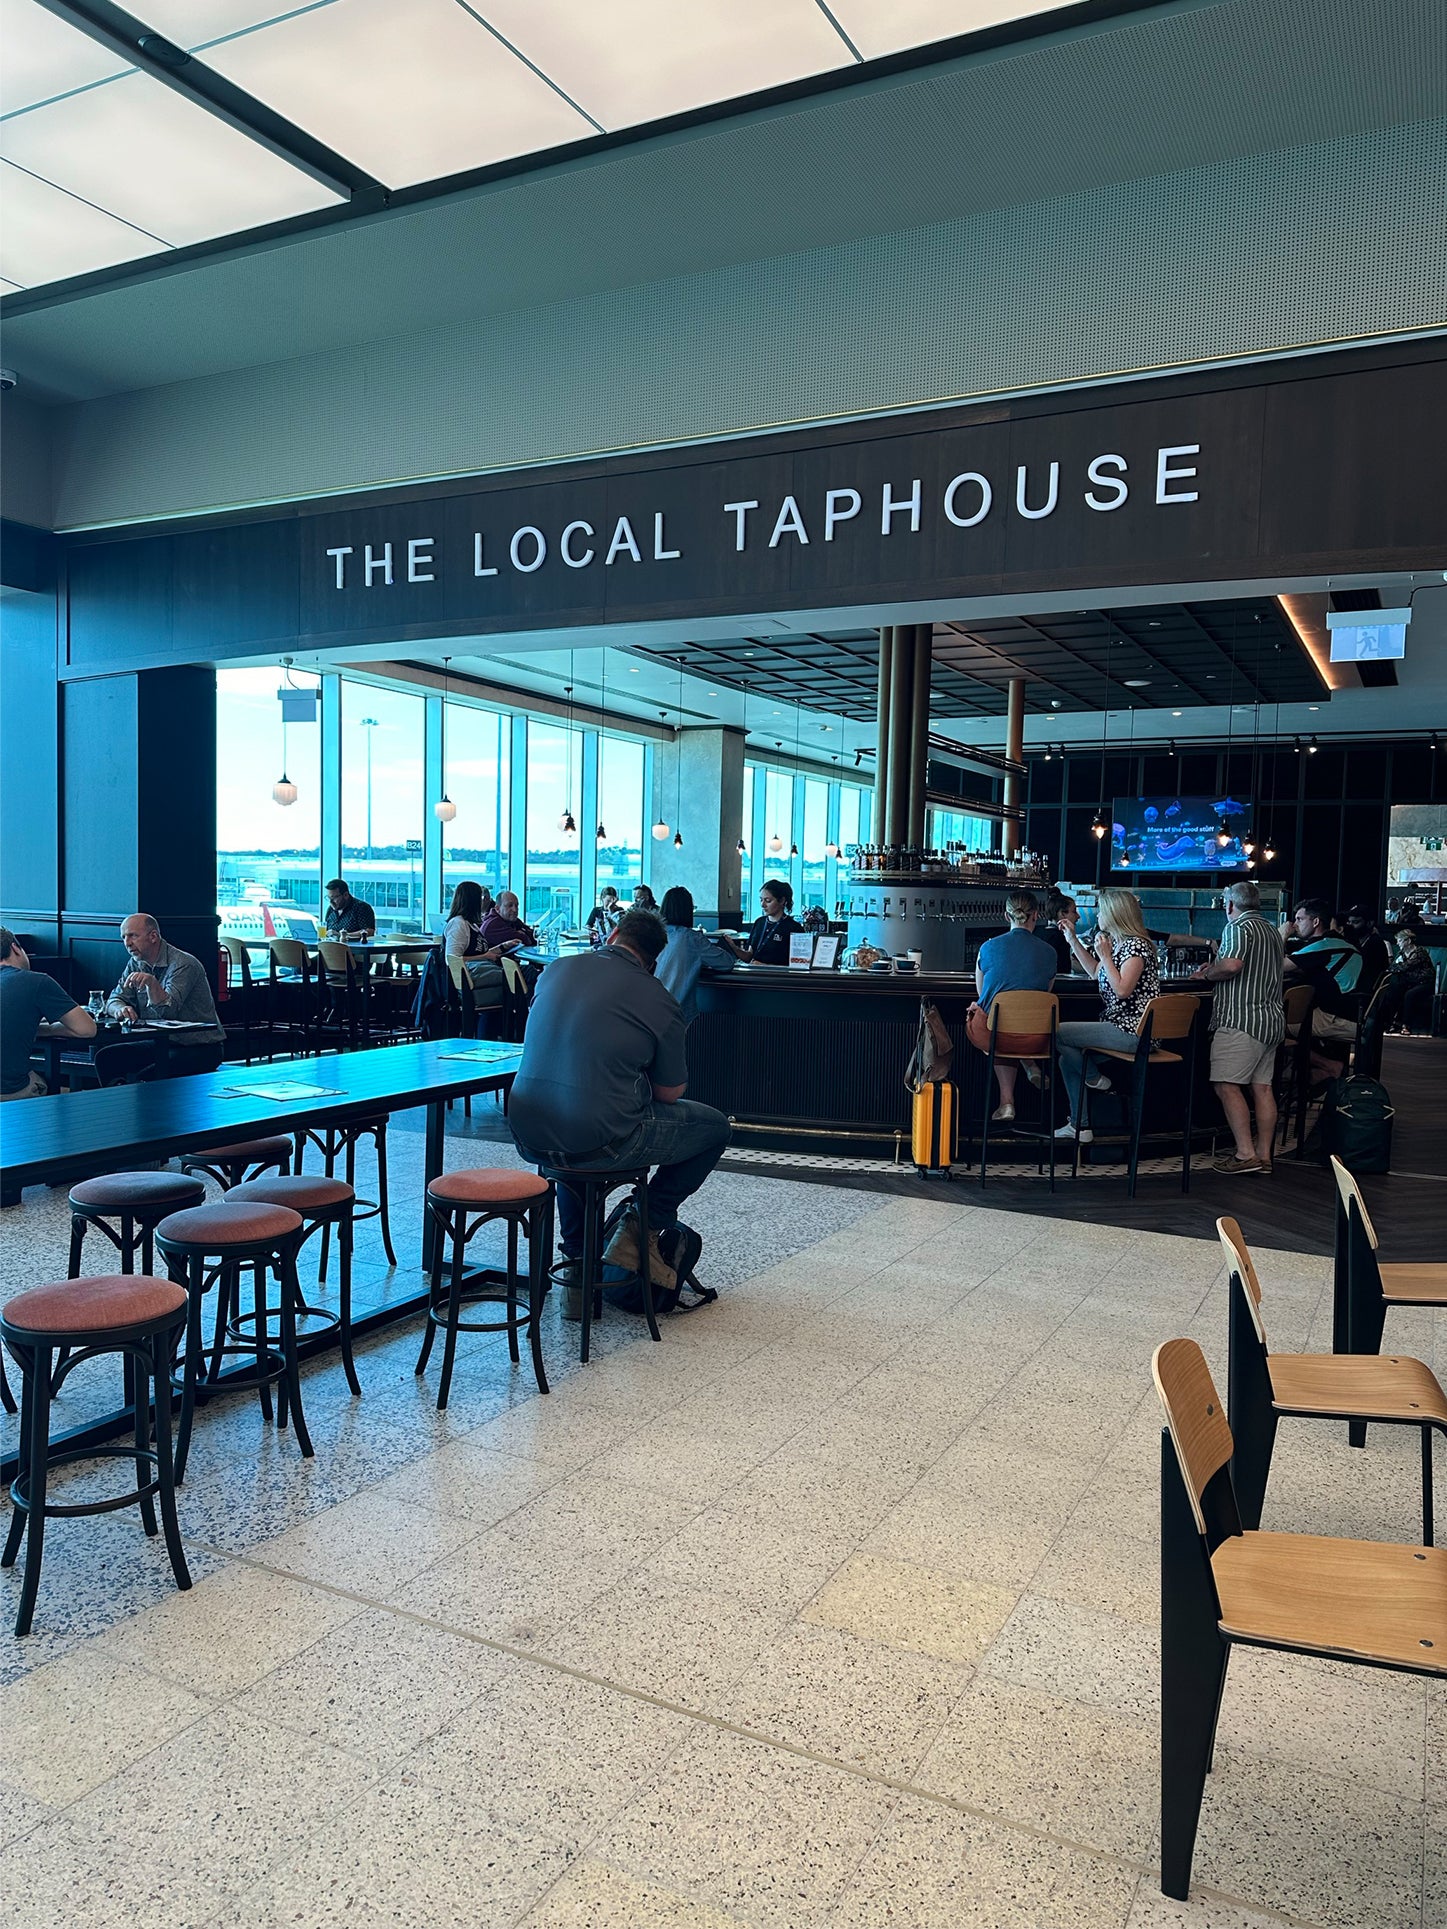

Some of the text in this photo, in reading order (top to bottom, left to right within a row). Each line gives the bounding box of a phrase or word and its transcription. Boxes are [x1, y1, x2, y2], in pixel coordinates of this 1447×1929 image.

[326, 444, 1201, 590] THE LOCAL TAPHOUSE
[407, 841, 421, 850] B24
[226, 912, 292, 921] QANAS
